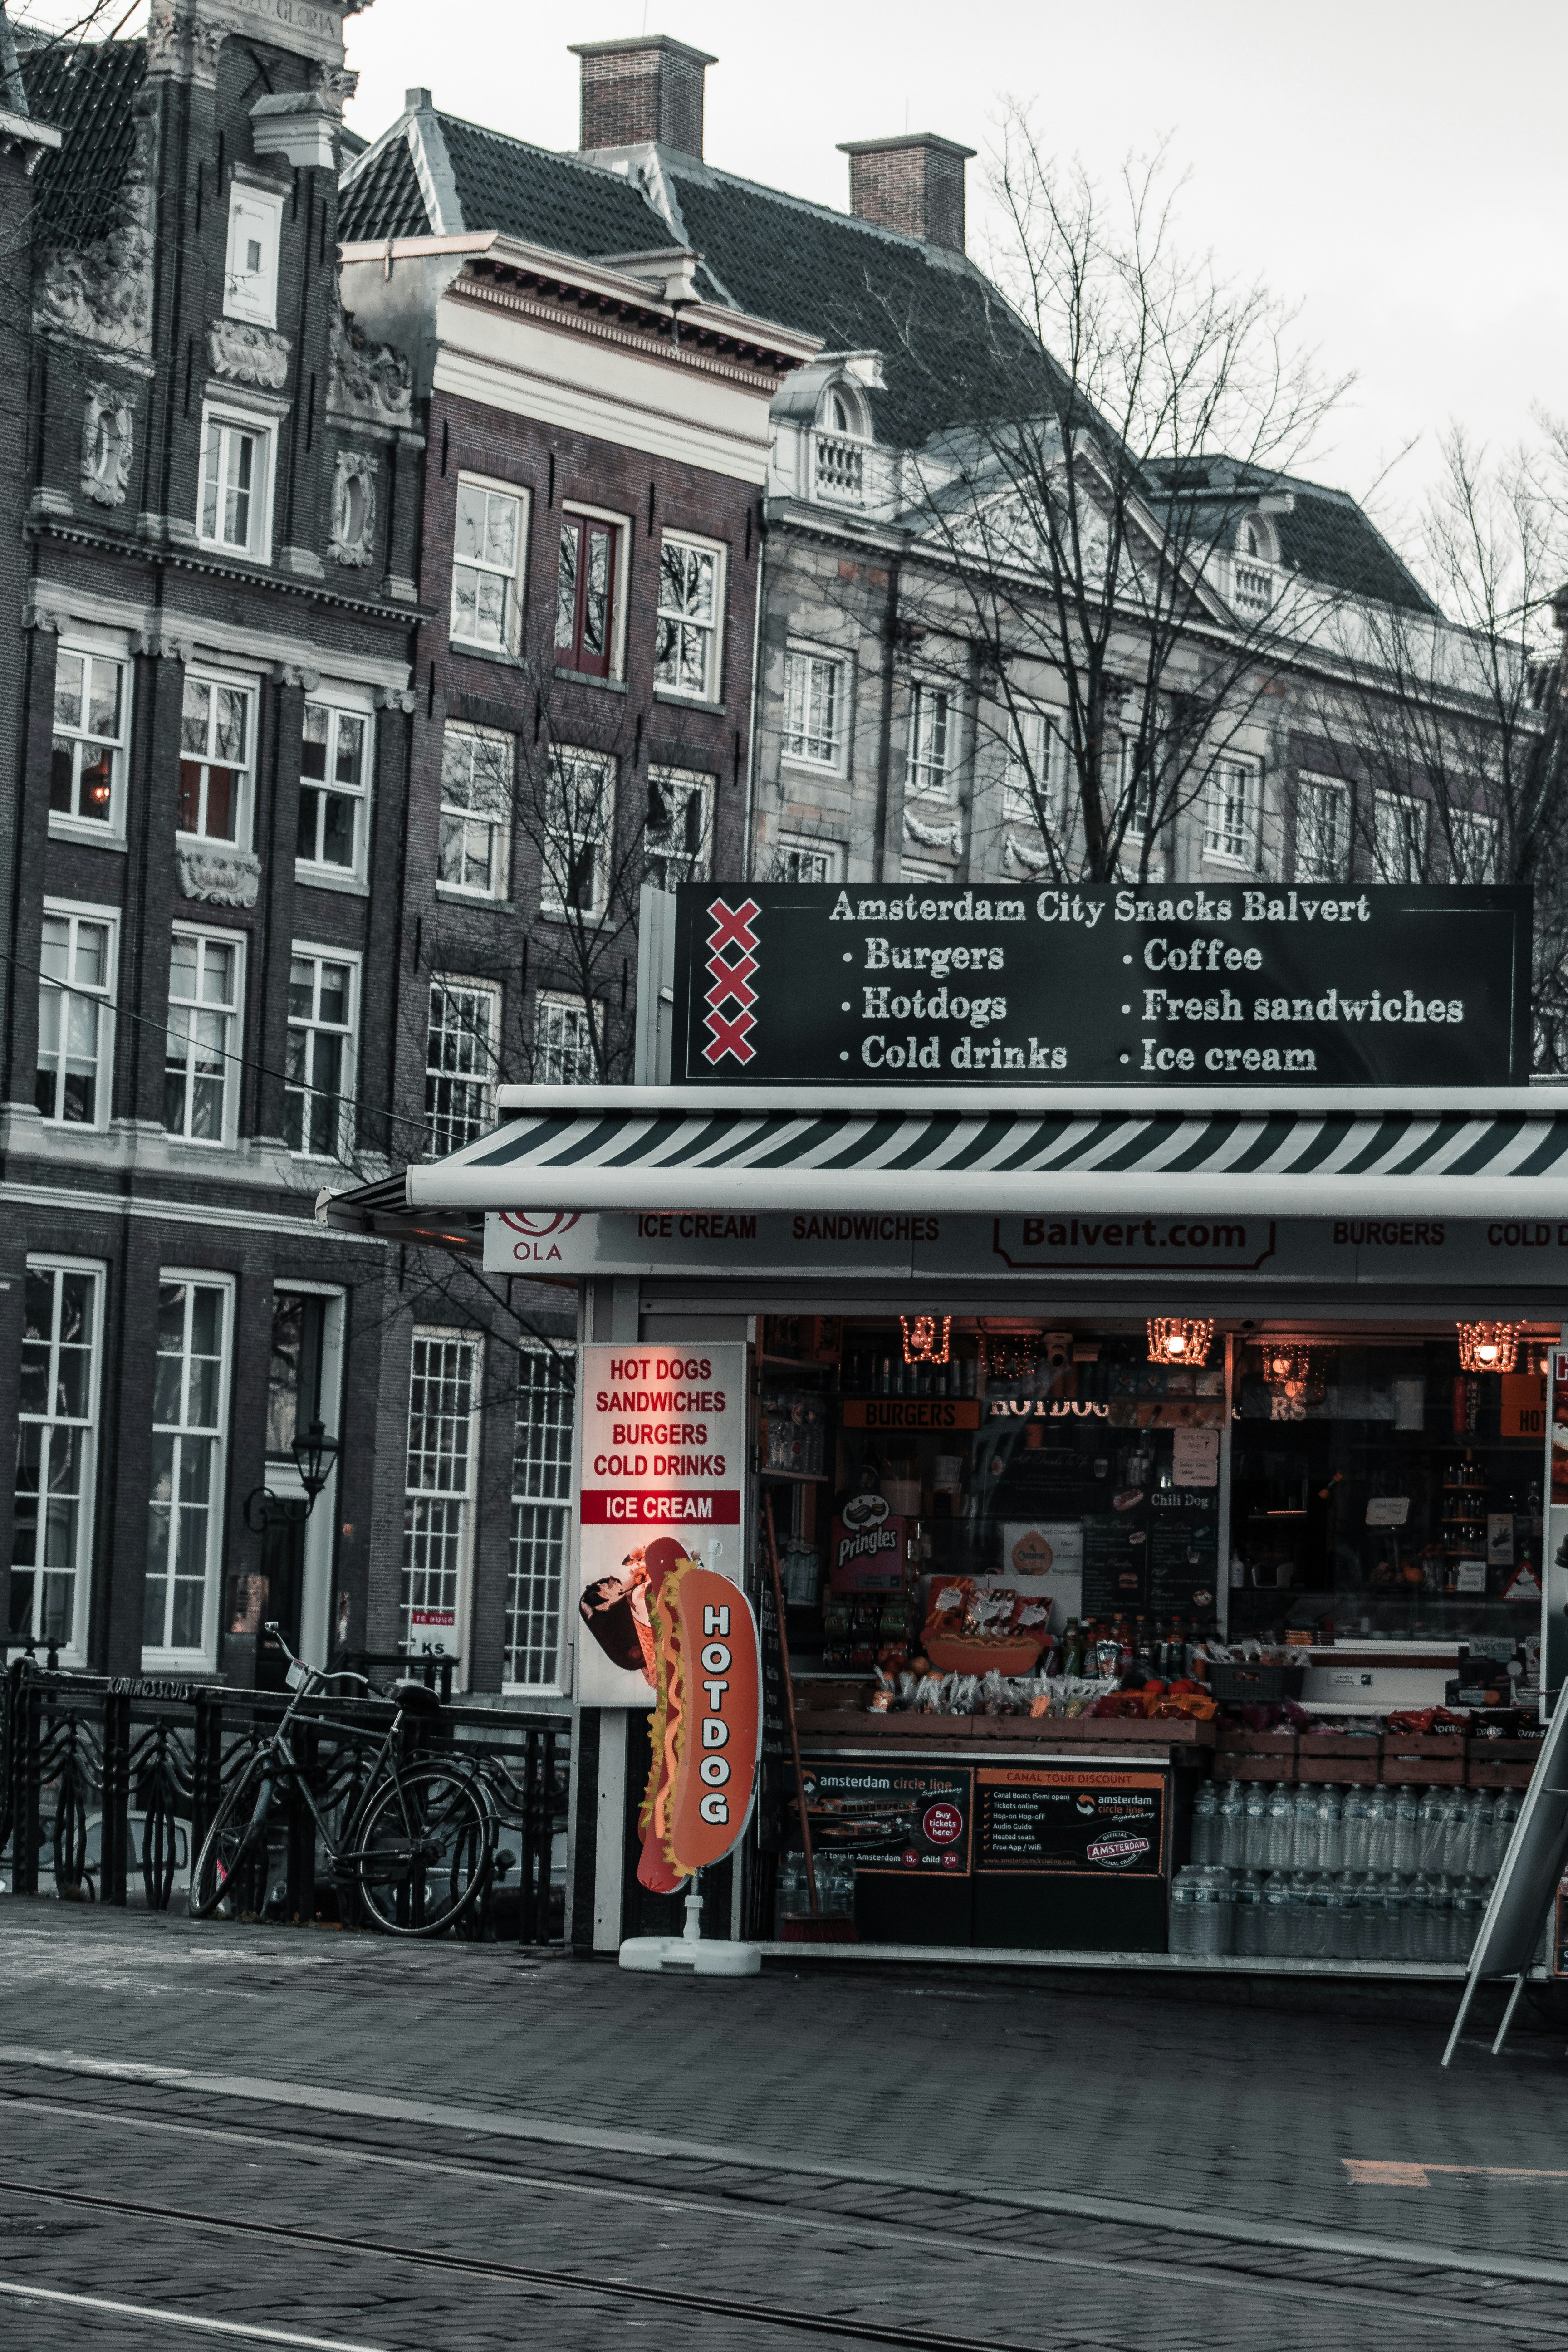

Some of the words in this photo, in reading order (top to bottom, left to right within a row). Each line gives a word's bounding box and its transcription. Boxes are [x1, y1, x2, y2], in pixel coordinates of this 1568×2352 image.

[829, 891, 1026, 921] Amsterdam
[1037, 891, 1104, 927] City
[1115, 891, 1232, 921] Snacks
[1242, 891, 1370, 921] Balvert
[864, 938, 1004, 978] Burgers
[1144, 938, 1262, 970] Coffee
[862, 987, 1007, 1028] Hotdogs
[1142, 989, 1243, 1021] Fresh
[1254, 989, 1463, 1023] sandwiches
[862, 1035, 940, 1068] Cold
[951, 1037, 1067, 1069] drinks
[1140, 1039, 1194, 1071] Ice
[1205, 1047, 1317, 1071] cream
[637, 1215, 672, 1239] ICE
[679, 1215, 757, 1239] CREAM
[792, 1216, 939, 1241] SANDWICHES
[1022, 1217, 1246, 1247] Balvert.com
[1333, 1222, 1445, 1246] BURGERS
[1487, 1223, 1551, 1247] COLD
[513, 1242, 563, 1261] OLA
[611, 1359, 650, 1380] HOT
[656, 1359, 711, 1380] DOGS
[596, 1391, 726, 1412] SANDWICHES
[865, 1403, 956, 1426] BURGERS
[613, 1423, 708, 1445] BURGERS
[594, 1455, 647, 1476] COLD
[654, 1455, 726, 1476] DRINKS
[606, 1497, 637, 1518] ICE
[643, 1497, 712, 1518] CREAM
[1152, 1494, 1181, 1506] Chili
[1185, 1494, 1209, 1509] Dog
[838, 1525, 897, 1568] Pringles
[429, 1616, 453, 1624] HUUR
[820, 1775, 889, 1789] amsterdam
[893, 1777, 925, 1789] circle
[930, 1778, 952, 1790] line
[1006, 1772, 1042, 1782] CANAL
[1046, 1773, 1075, 1783] TOUR
[1078, 1774, 1132, 1784] DISCOUNT
[921, 1786, 962, 1797] Sightseeing
[1051, 1793, 1070, 1801] open)
[1098, 1795, 1152, 1805] amsterdam
[936, 1810, 951, 1819] Buy
[993, 1813, 1017, 1821] Hop-on
[1098, 1804, 1122, 1814] circle
[1126, 1805, 1144, 1814] line
[1111, 1811, 1155, 1823] Sightseeing
[929, 1819, 956, 1828] tickets
[932, 1828, 953, 1837] here!
[1102, 1832, 1128, 1841] OFFICIAL
[856, 1853, 900, 1862] Amsterdam
[1008, 1844, 1022, 1852] App
[1091, 1840, 1146, 1857] AMSTERDAM
[921, 1855, 941, 1863] child
[1101, 1858, 1120, 1867] CANAL
[1119, 1852, 1137, 1865] CRUISE
